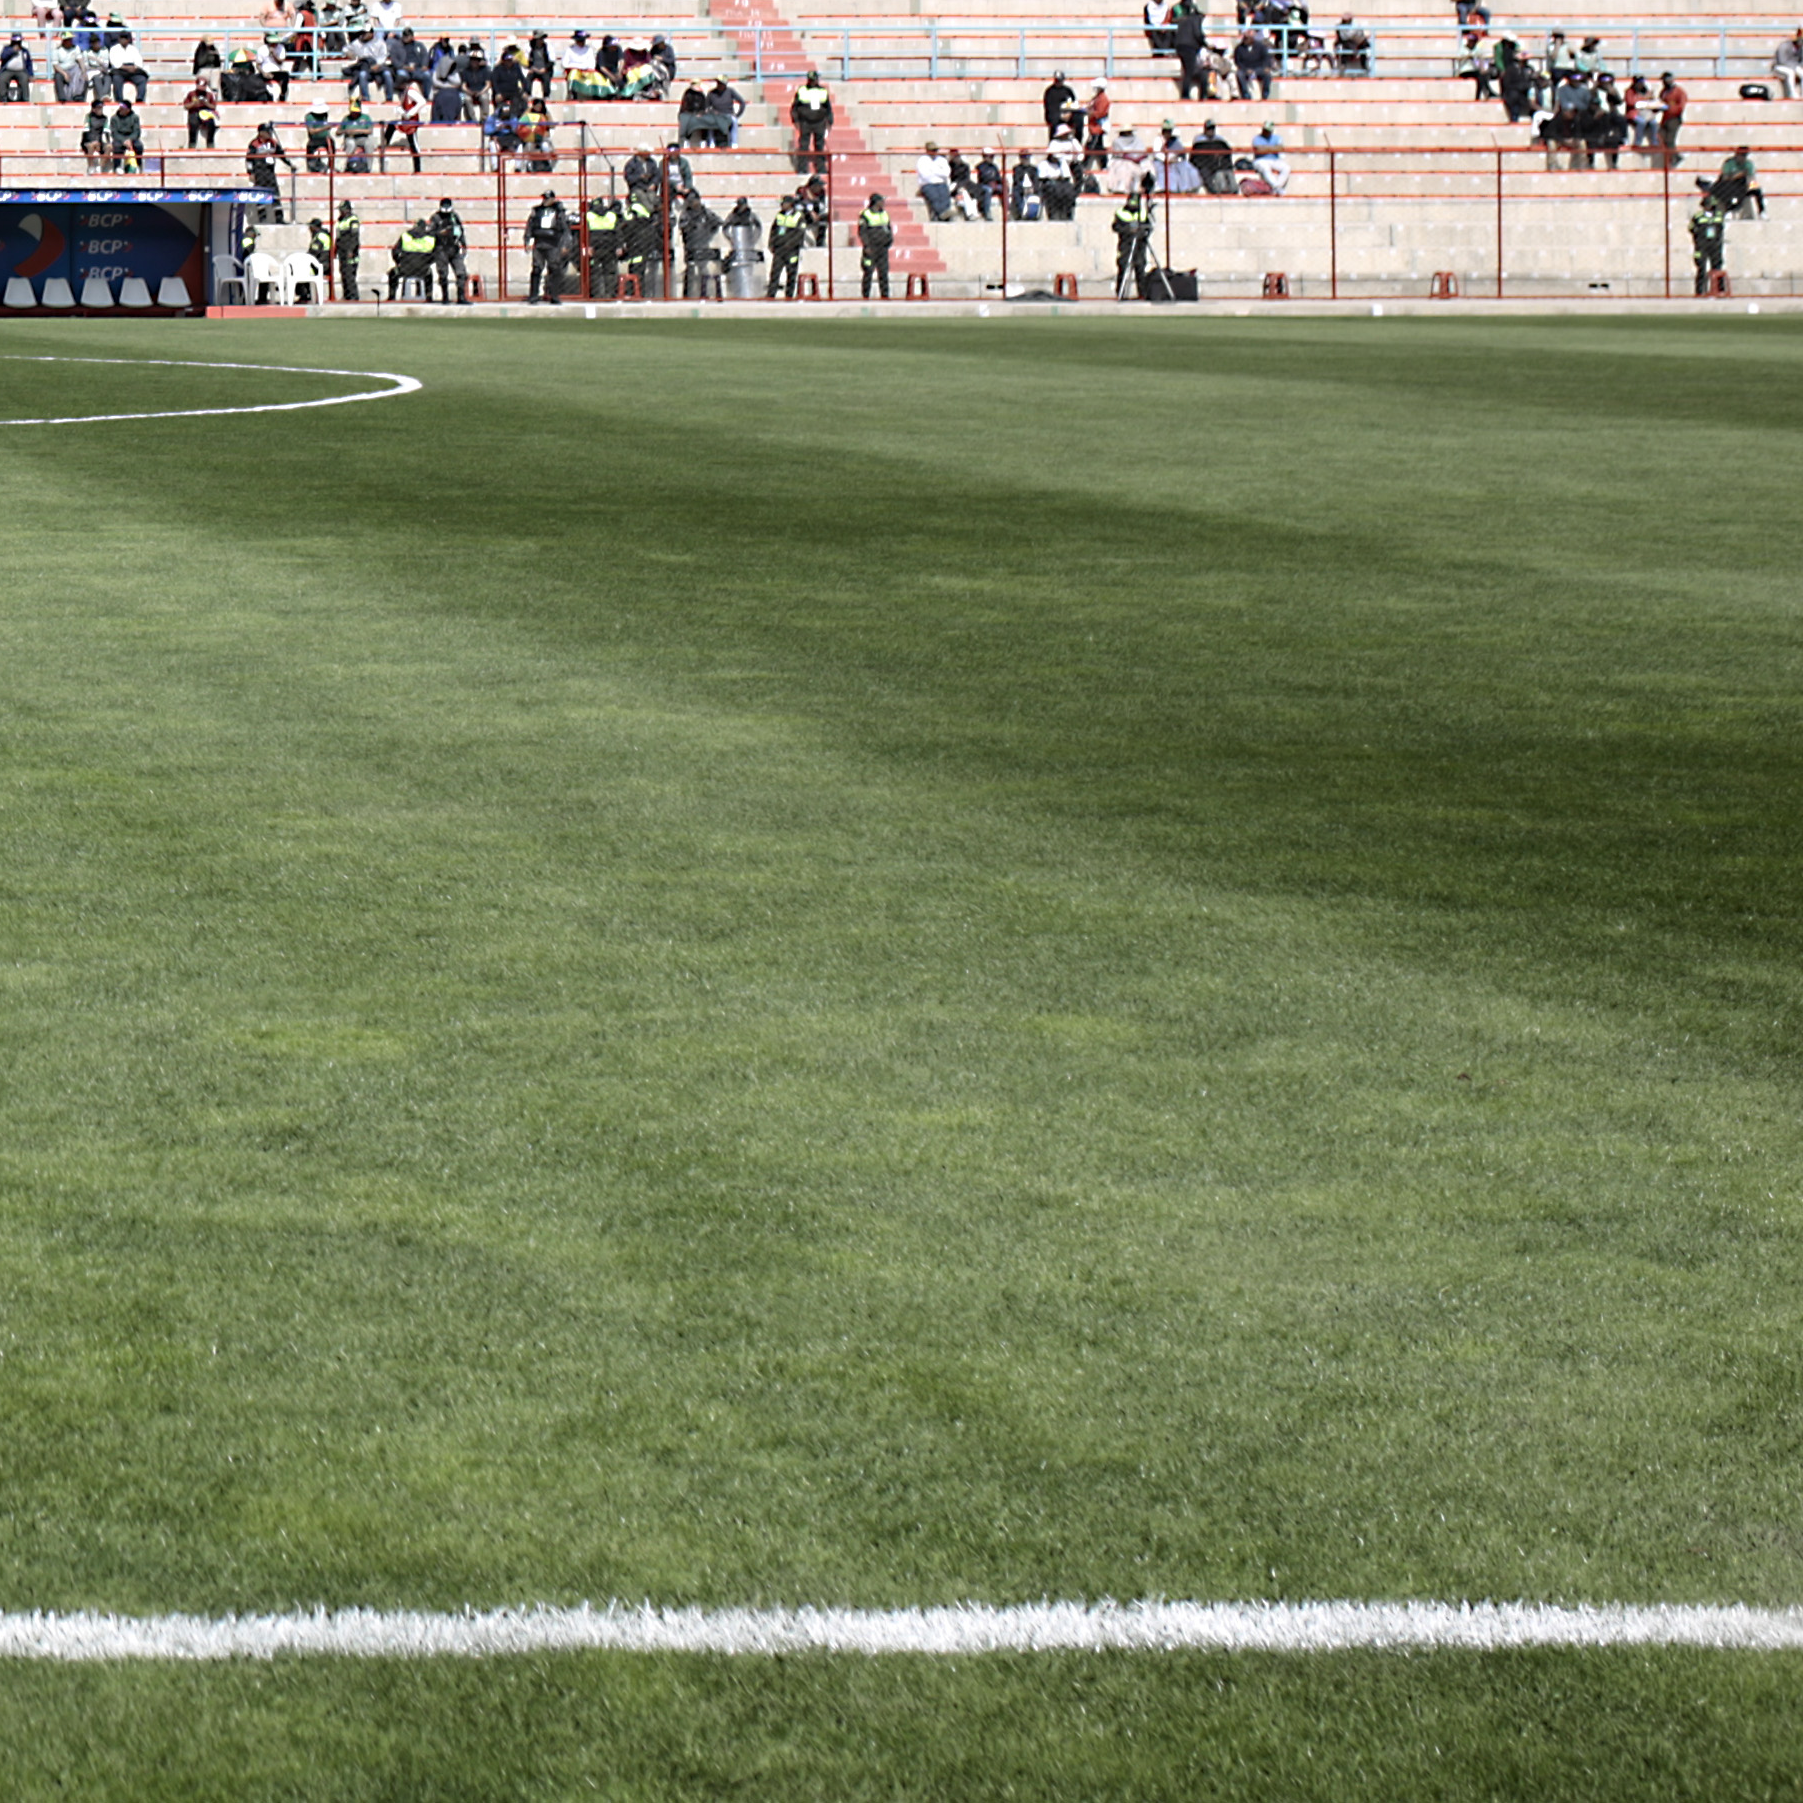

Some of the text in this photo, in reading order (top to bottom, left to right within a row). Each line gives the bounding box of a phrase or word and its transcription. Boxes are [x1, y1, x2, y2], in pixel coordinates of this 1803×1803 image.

[37, 191, 62, 202] BCP
[88, 191, 113, 202] BCP
[138, 191, 163, 202] BCP
[189, 191, 214, 202] BCP
[239, 191, 264, 202] BCP
[88, 214, 122, 228] BCP
[88, 240, 122, 254] BCP
